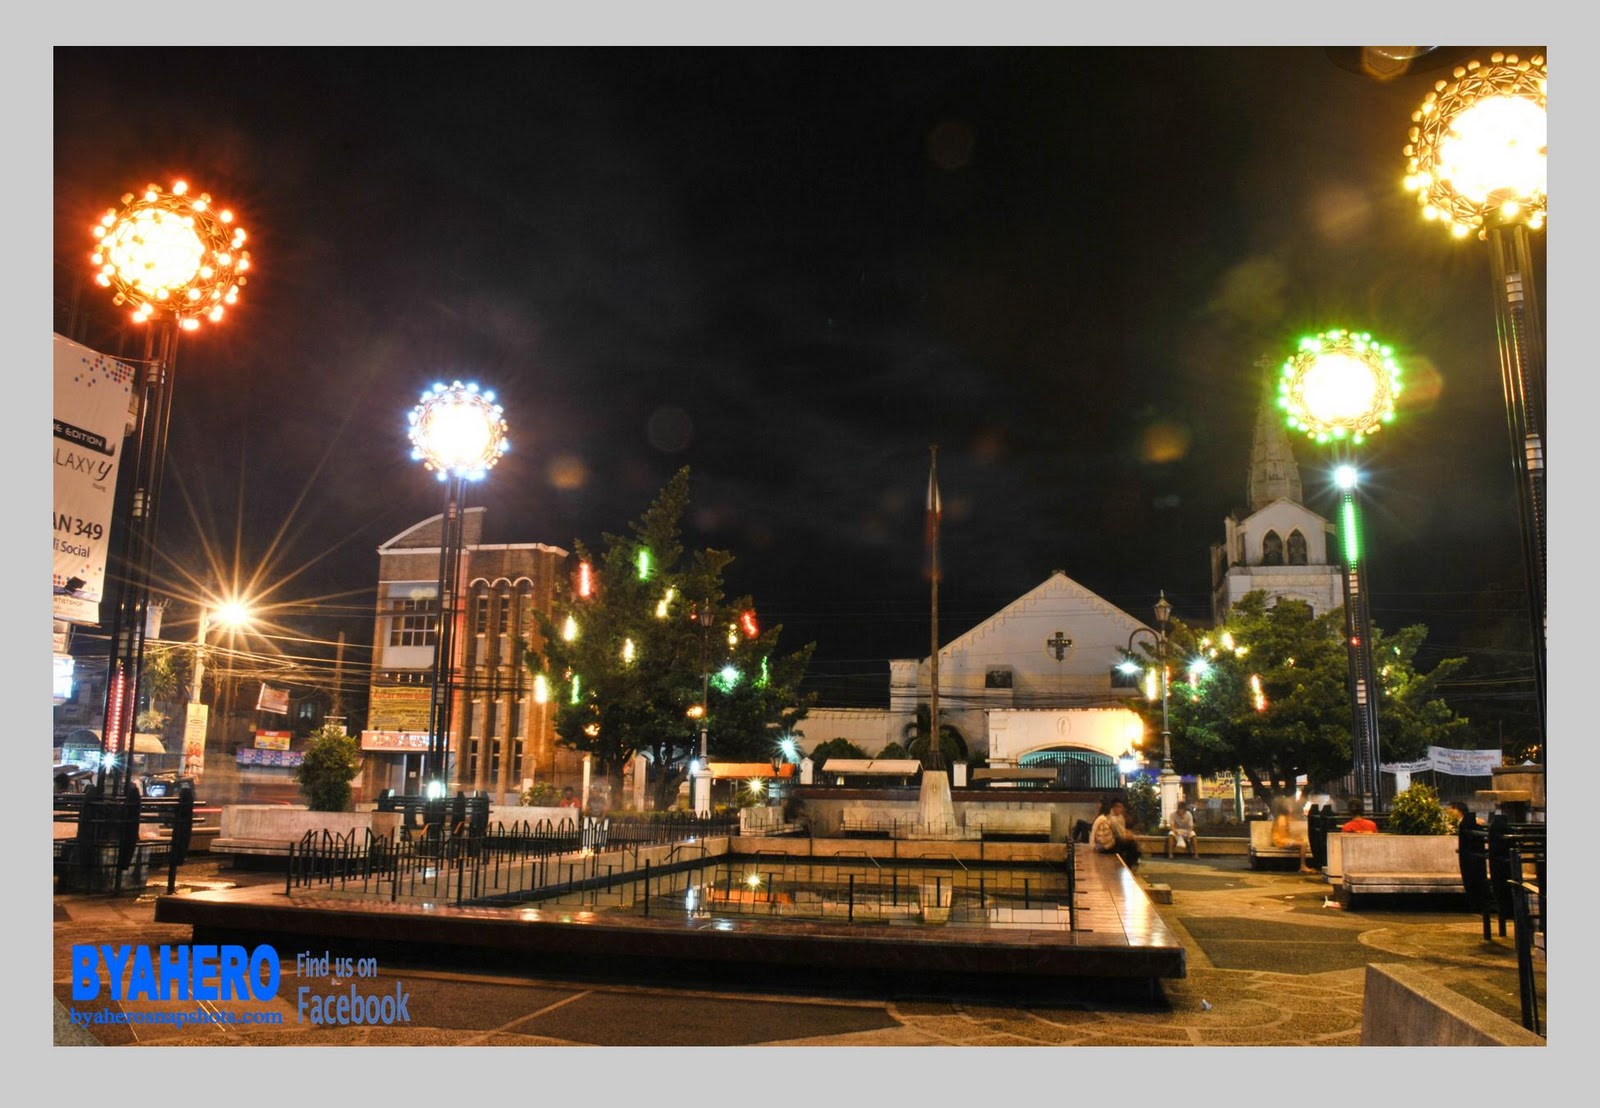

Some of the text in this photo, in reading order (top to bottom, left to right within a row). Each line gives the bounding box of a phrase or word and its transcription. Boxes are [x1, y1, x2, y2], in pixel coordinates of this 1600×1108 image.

[65, 427, 103, 447] EDITION
[74, 518, 103, 540] 349
[61, 540, 91, 558] Social
